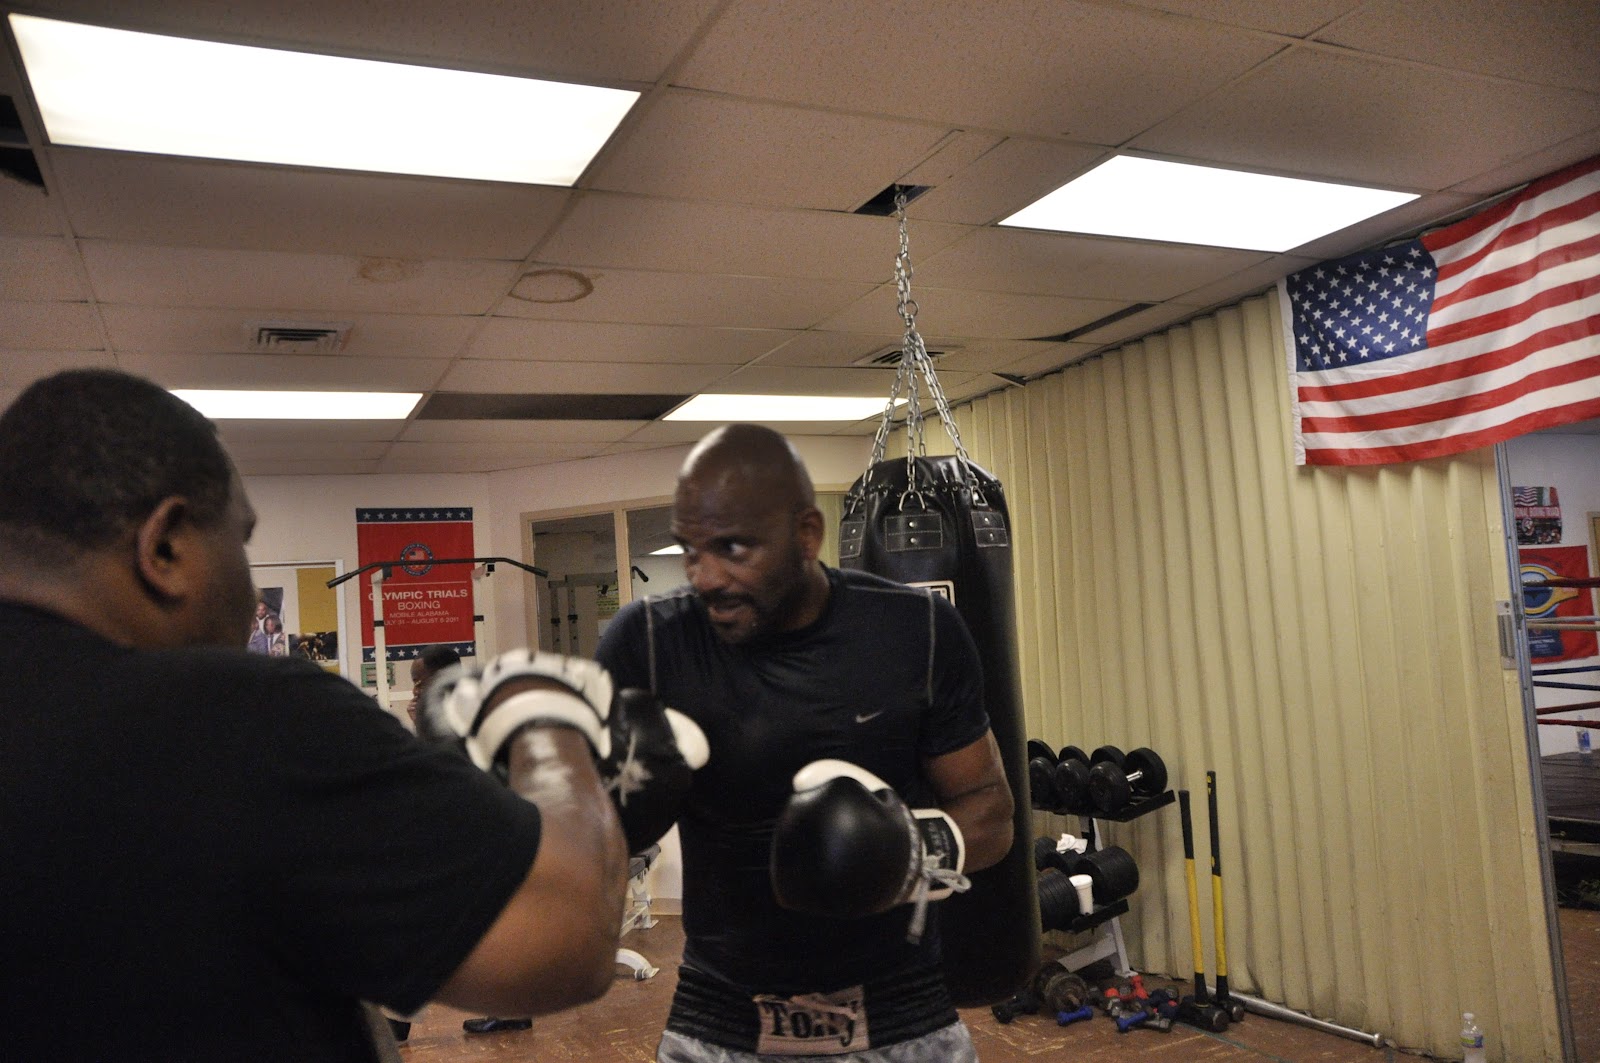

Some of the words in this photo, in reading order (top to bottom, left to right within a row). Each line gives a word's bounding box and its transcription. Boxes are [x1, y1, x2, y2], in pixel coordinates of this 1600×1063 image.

[368, 591, 423, 601] OYMPIC
[426, 589, 468, 599] TRIALS
[397, 600, 440, 611] BOXING
